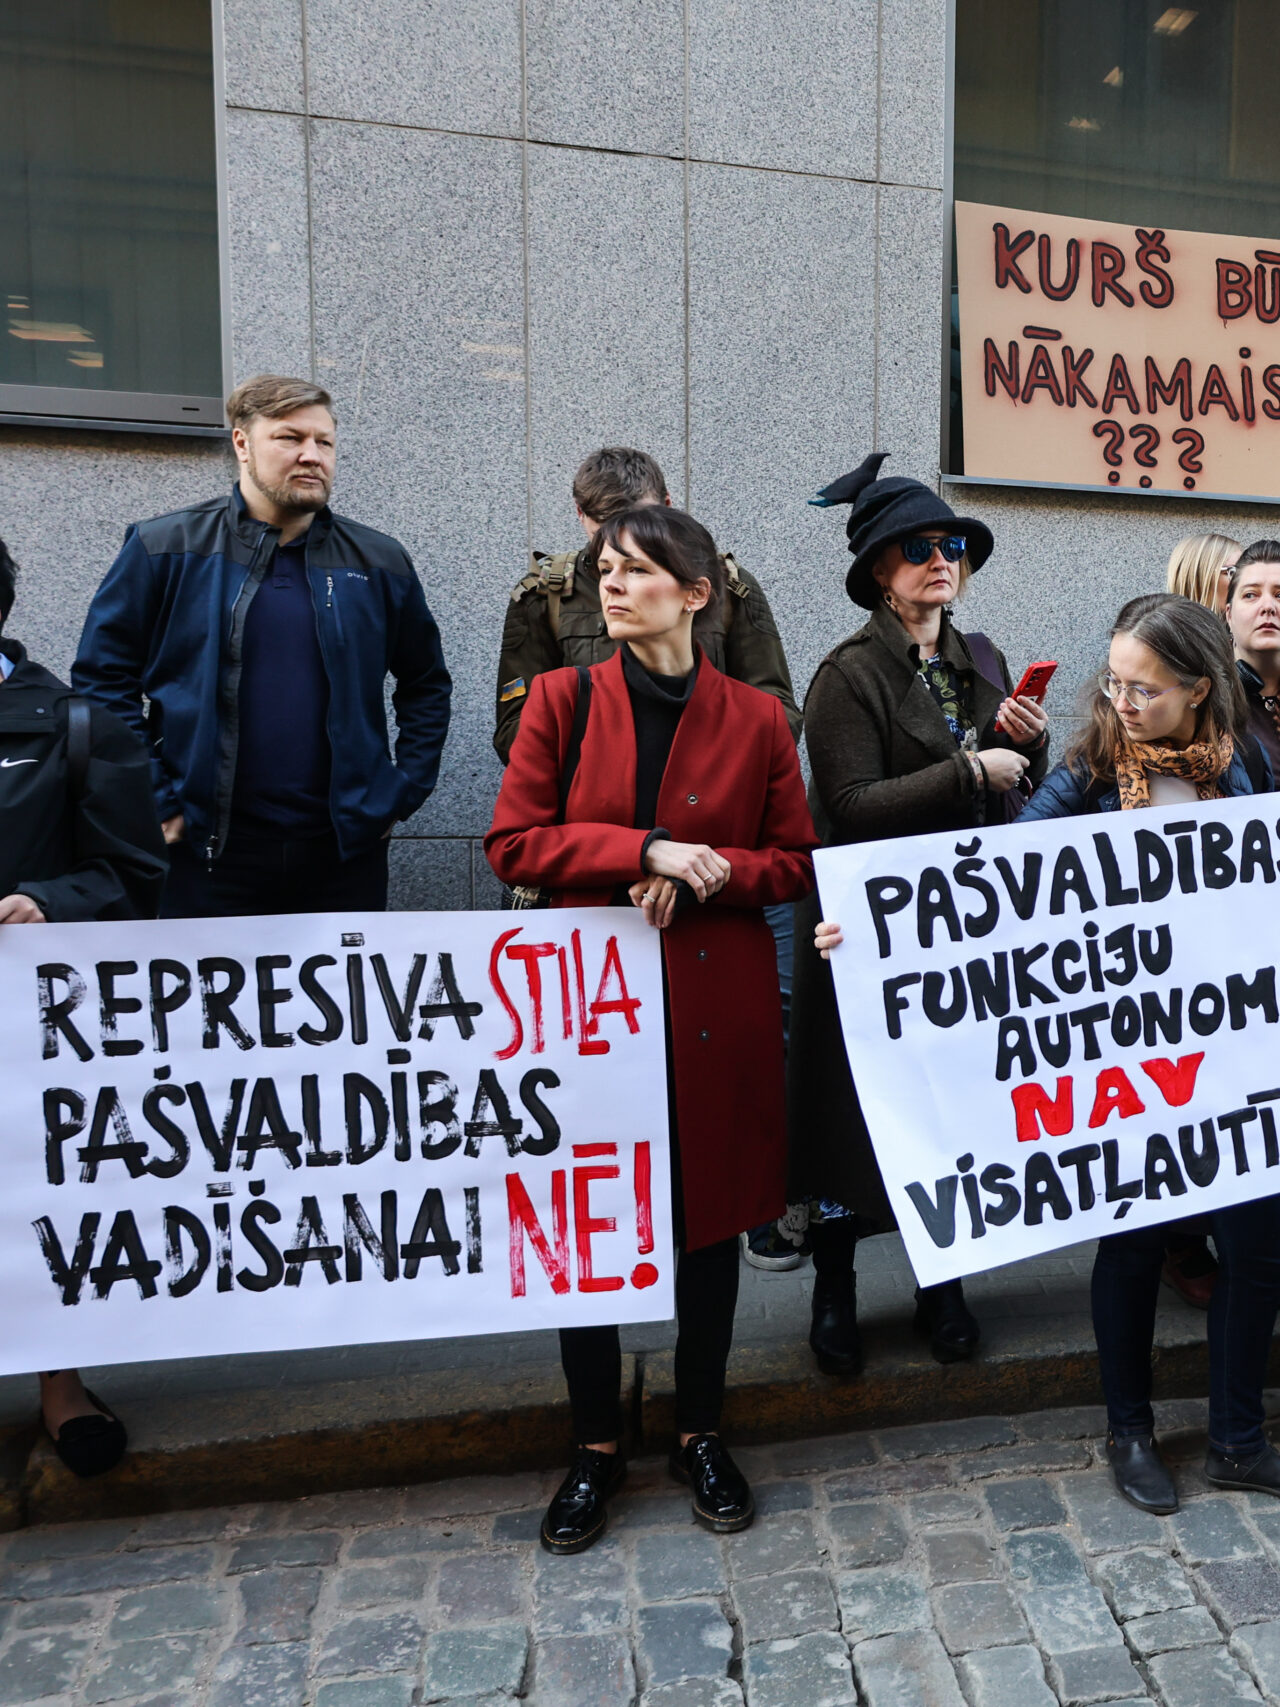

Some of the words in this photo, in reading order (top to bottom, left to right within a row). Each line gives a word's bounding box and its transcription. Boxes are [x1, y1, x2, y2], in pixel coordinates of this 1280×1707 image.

[993, 222, 1175, 309] KURŠ
[1093, 419, 1205, 490] ???
[35, 932, 483, 1062] REPRESĪVA
[487, 927, 641, 1061] STILA
[42, 1048, 562, 1185] PAŠVALDĪBAS
[1010, 1051, 1206, 1143] NAV
[30, 1178, 481, 1306] VADĪŠANAI
[505, 1140, 660, 1299] NĒ!
